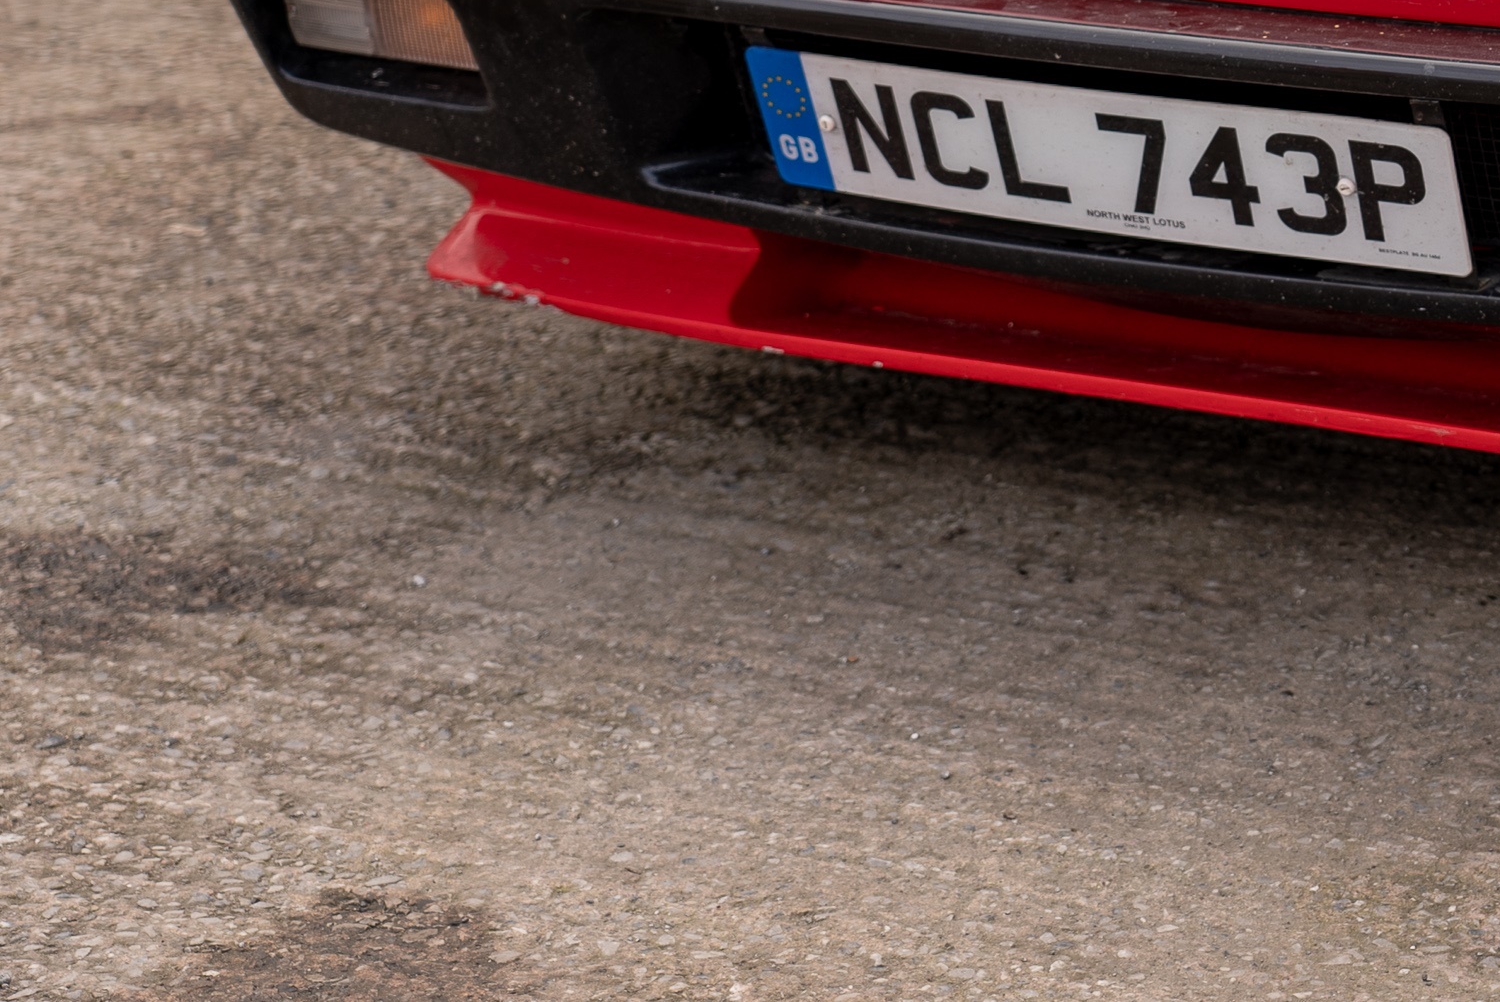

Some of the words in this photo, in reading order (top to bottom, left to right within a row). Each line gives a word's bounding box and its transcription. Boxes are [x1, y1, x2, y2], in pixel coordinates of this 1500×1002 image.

[779, 133, 819, 163] GB
[830, 78, 1072, 204] NCL
[1095, 112, 1426, 243] 743P
[1087, 209, 1121, 221] NORTH
[1122, 214, 1150, 224] WEST
[1153, 218, 1186, 229] LOTUS
